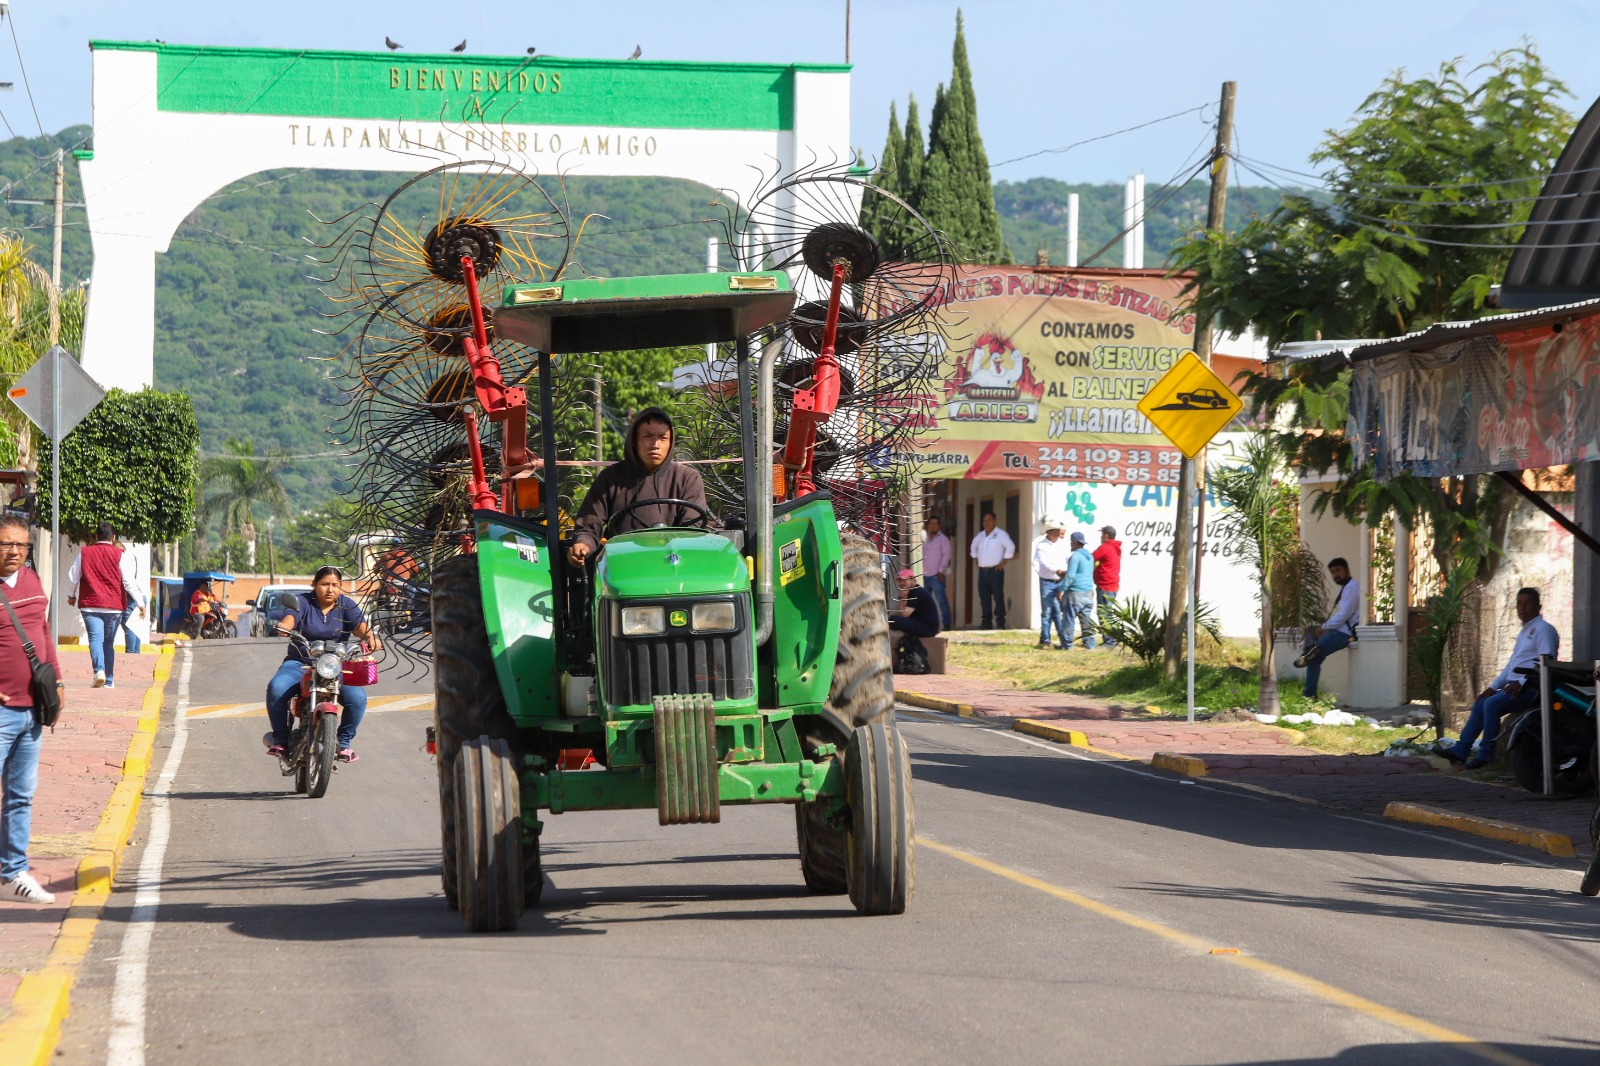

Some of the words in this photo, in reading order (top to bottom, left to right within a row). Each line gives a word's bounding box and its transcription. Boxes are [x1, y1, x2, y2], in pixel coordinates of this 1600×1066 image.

[389, 67, 562, 94] BIENVENIDOS
[469, 96, 483, 118] A
[288, 124, 447, 151] TLAPANALA
[465, 129, 562, 155] PUEBLO
[579, 134, 658, 157] AMIGO
[1007, 275, 1079, 298] POLLOS
[1083, 279, 1197, 335] ROSTIZADOS
[1040, 321, 1135, 340] CONTAMOS
[1055, 350, 1090, 367] CON
[1092, 345, 1195, 371] SERVICI
[1047, 381, 1068, 397] AL
[956, 402, 1029, 420] ARIES
[928, 453, 970, 465] IBARRA
[1038, 447, 1078, 462] 244
[1084, 448, 1121, 463] 109
[1127, 450, 1152, 465] 33
[1158, 451, 1182, 466] 82
[1039, 464, 1079, 479] 244
[1084, 465, 1120, 480] 130
[1125, 467, 1150, 482] 85
[1157, 468, 1181, 483] 85
